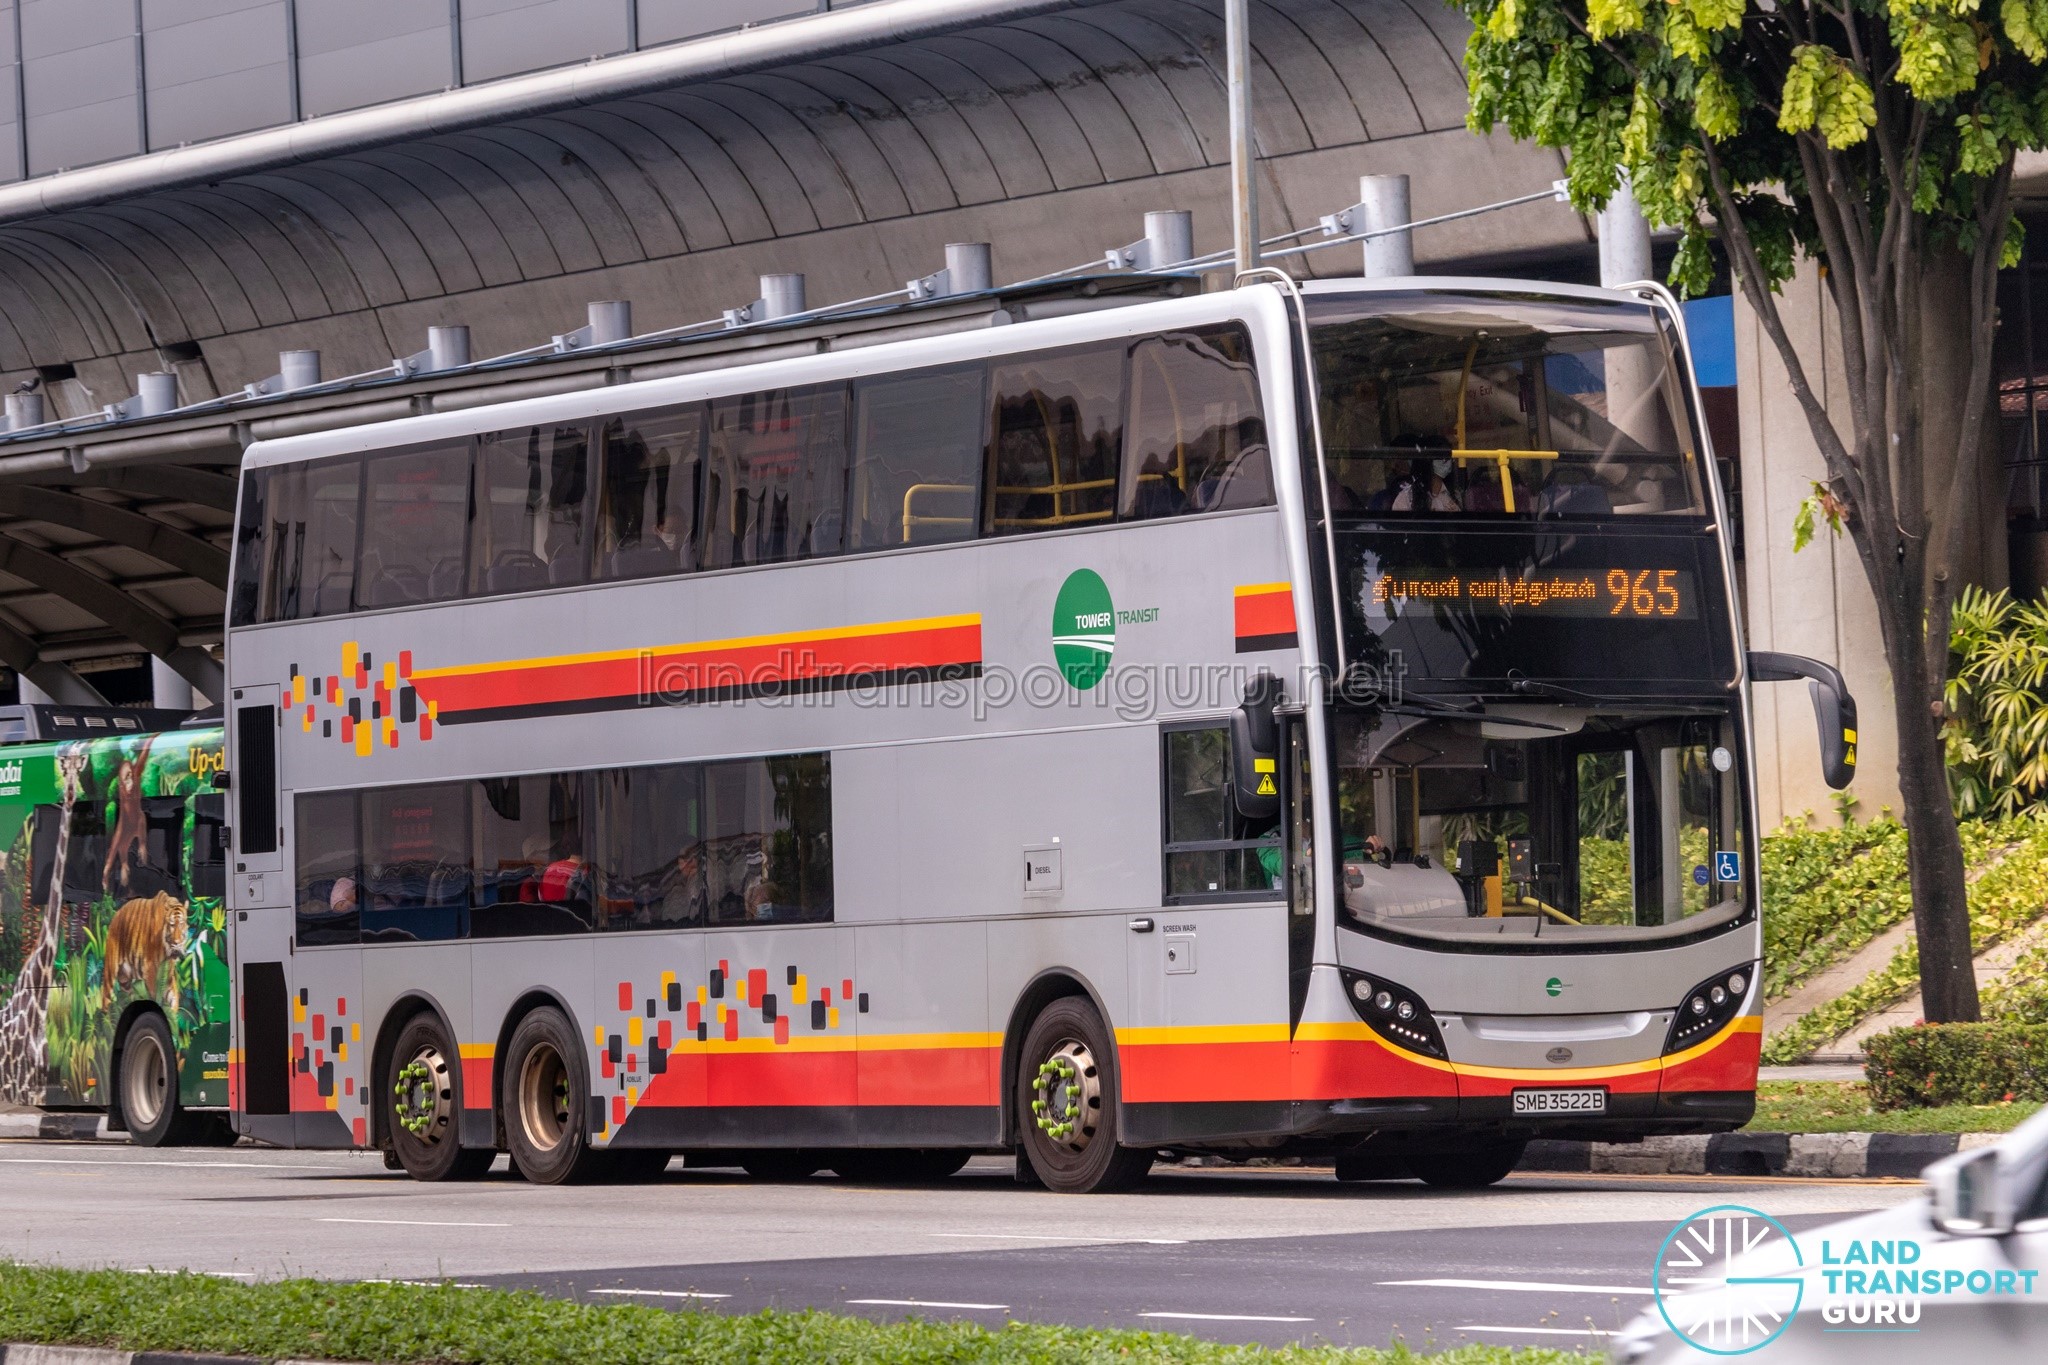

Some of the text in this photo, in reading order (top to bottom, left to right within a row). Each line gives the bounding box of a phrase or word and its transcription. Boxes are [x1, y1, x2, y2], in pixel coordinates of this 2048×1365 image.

[1372, 575, 1595, 605] தீபாவளி வாழ்த்துக்கள்
[1607, 569, 1679, 616] 965
[1075, 608, 1159, 630] TOWER TRANSIT
[1035, 866, 1051, 874] DIESEL
[1182, 924, 1197, 932] WASH
[1515, 1093, 1603, 1110] SMB3522B
